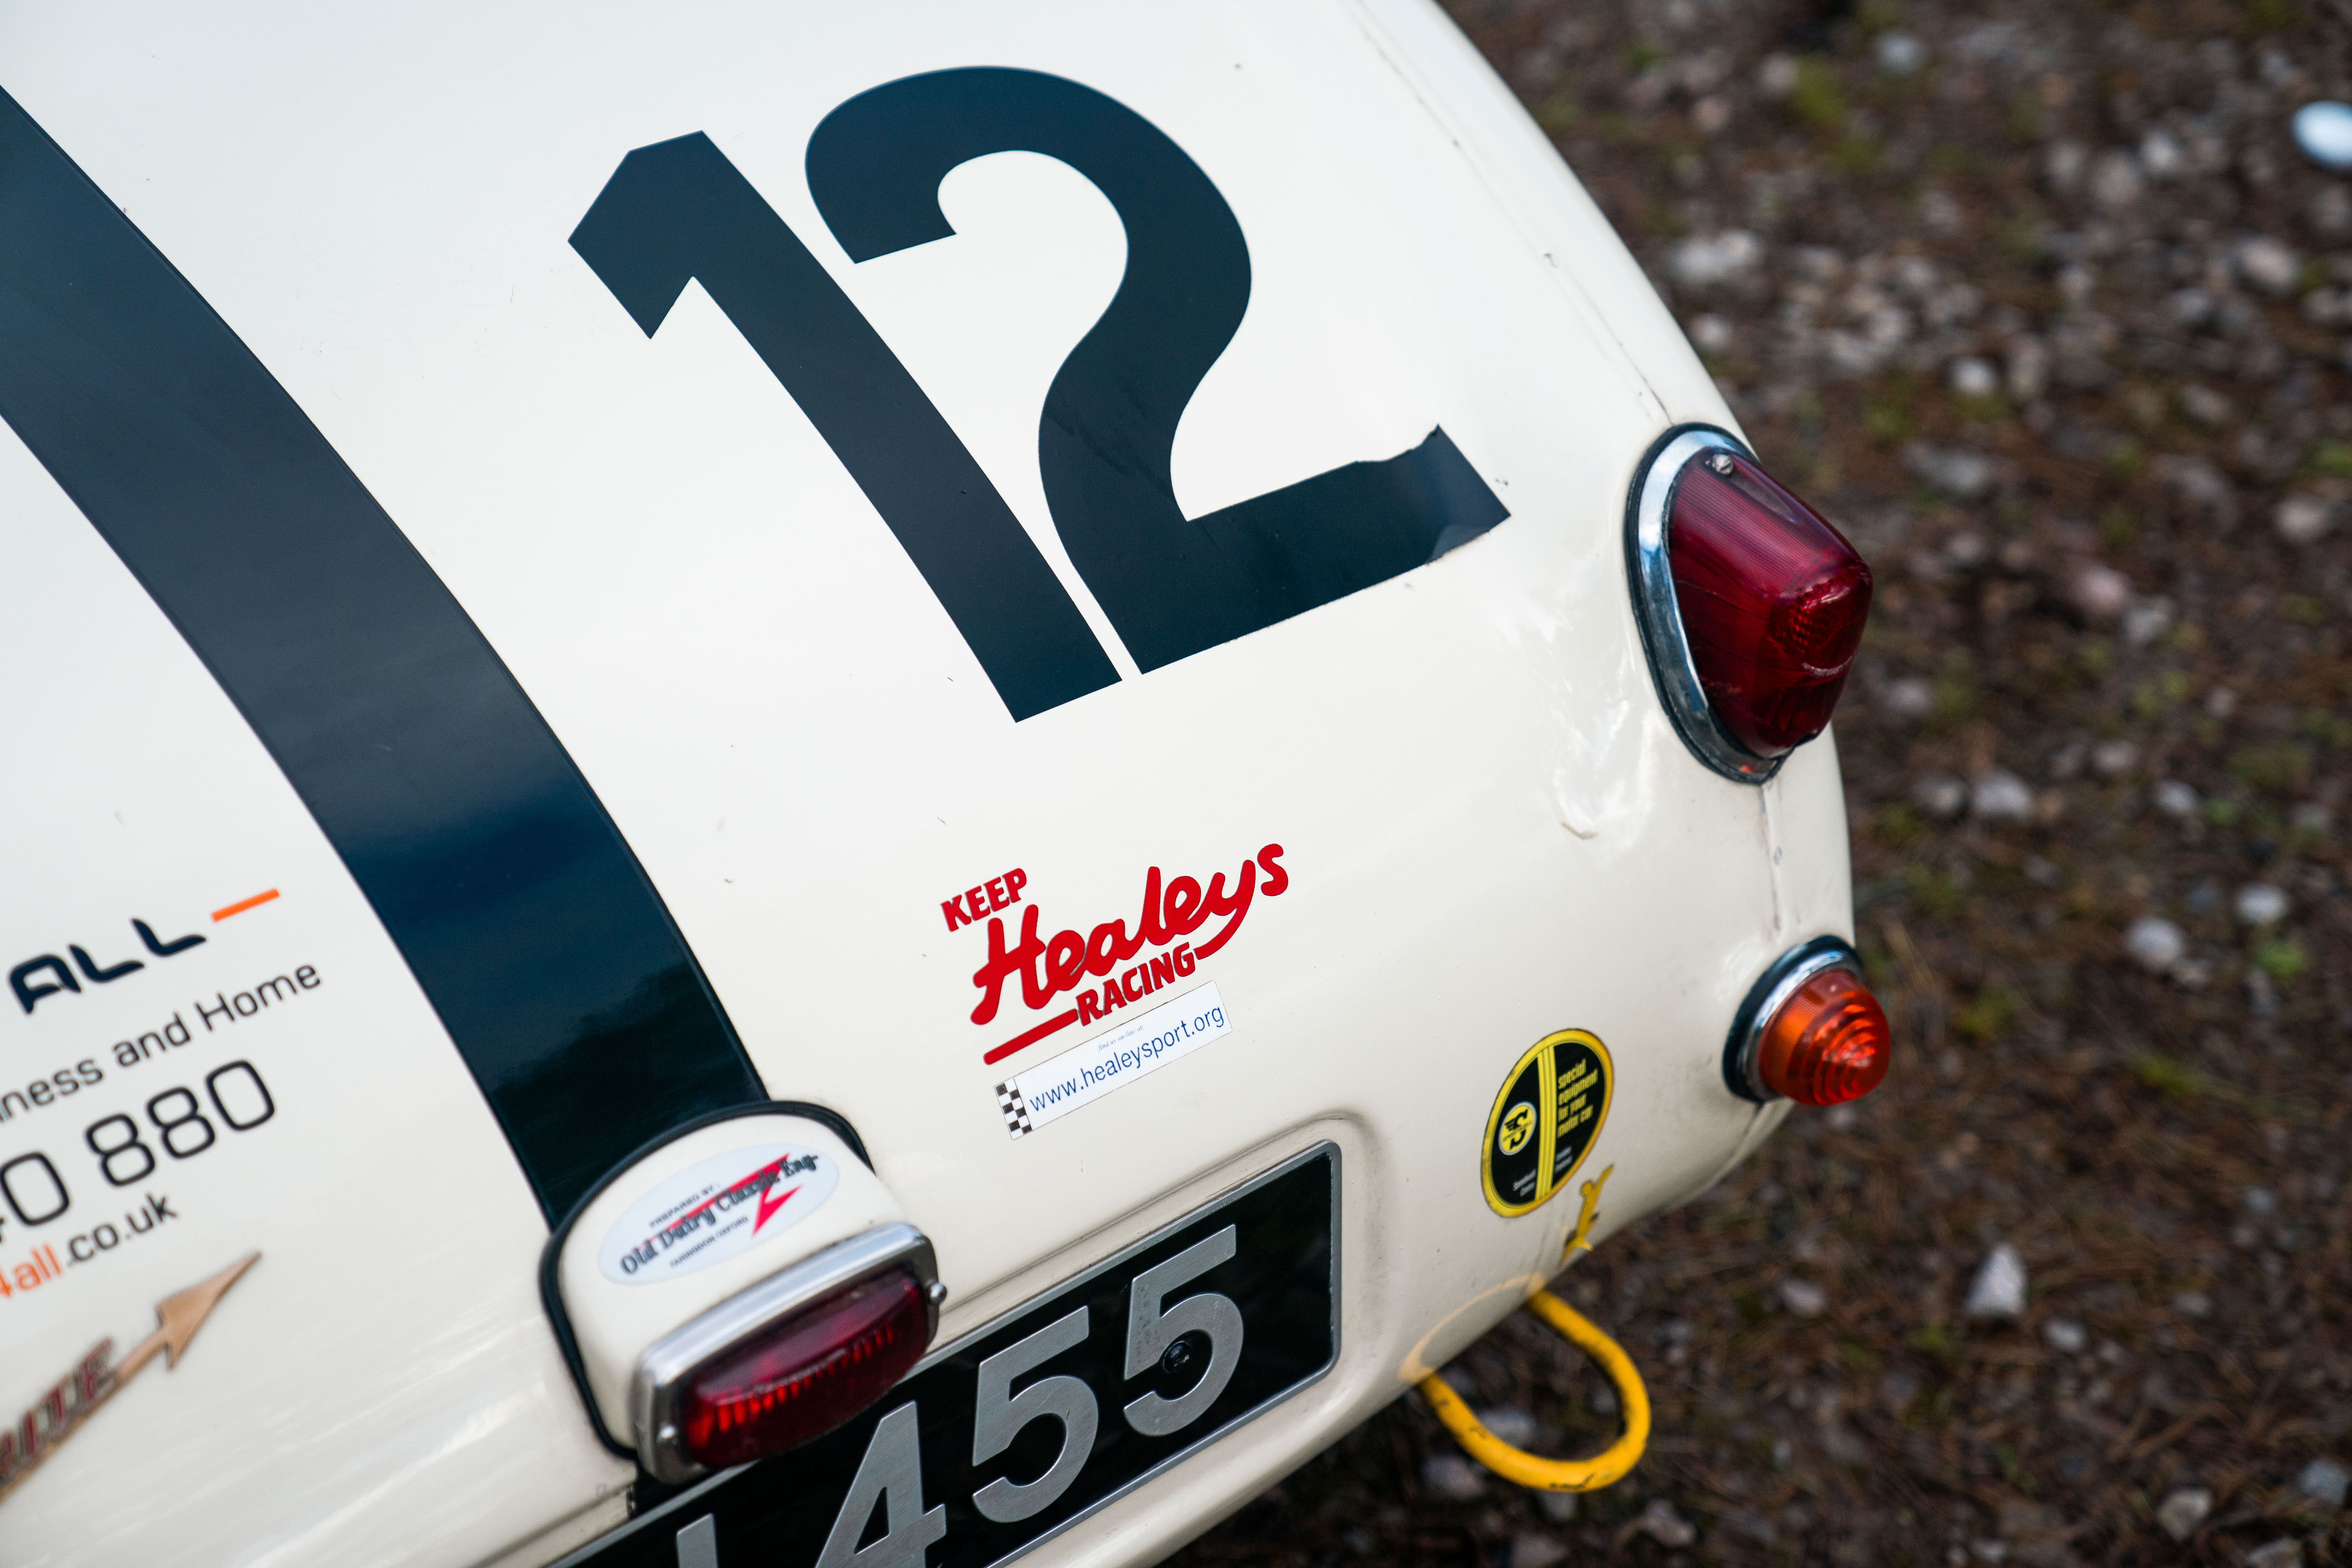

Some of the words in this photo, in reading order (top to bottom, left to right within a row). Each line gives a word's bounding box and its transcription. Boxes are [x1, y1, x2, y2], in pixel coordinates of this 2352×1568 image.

[568, 66, 1511, 722] 12
[941, 868, 1027, 932] KEEP
[970, 843, 1289, 1025] Healeys
[8, 917, 207, 1014] ALL
[1075, 942, 1196, 1027] RACING
[0, 1059, 103, 1123] ness
[112, 1011, 191, 1067] and
[194, 964, 322, 1031] Home
[1029, 1004, 1225, 1112] www.healeysport.org
[83, 1059, 276, 1188] 880
[620, 1239, 658, 1274] Old
[815, 1223, 1244, 1568] 455
